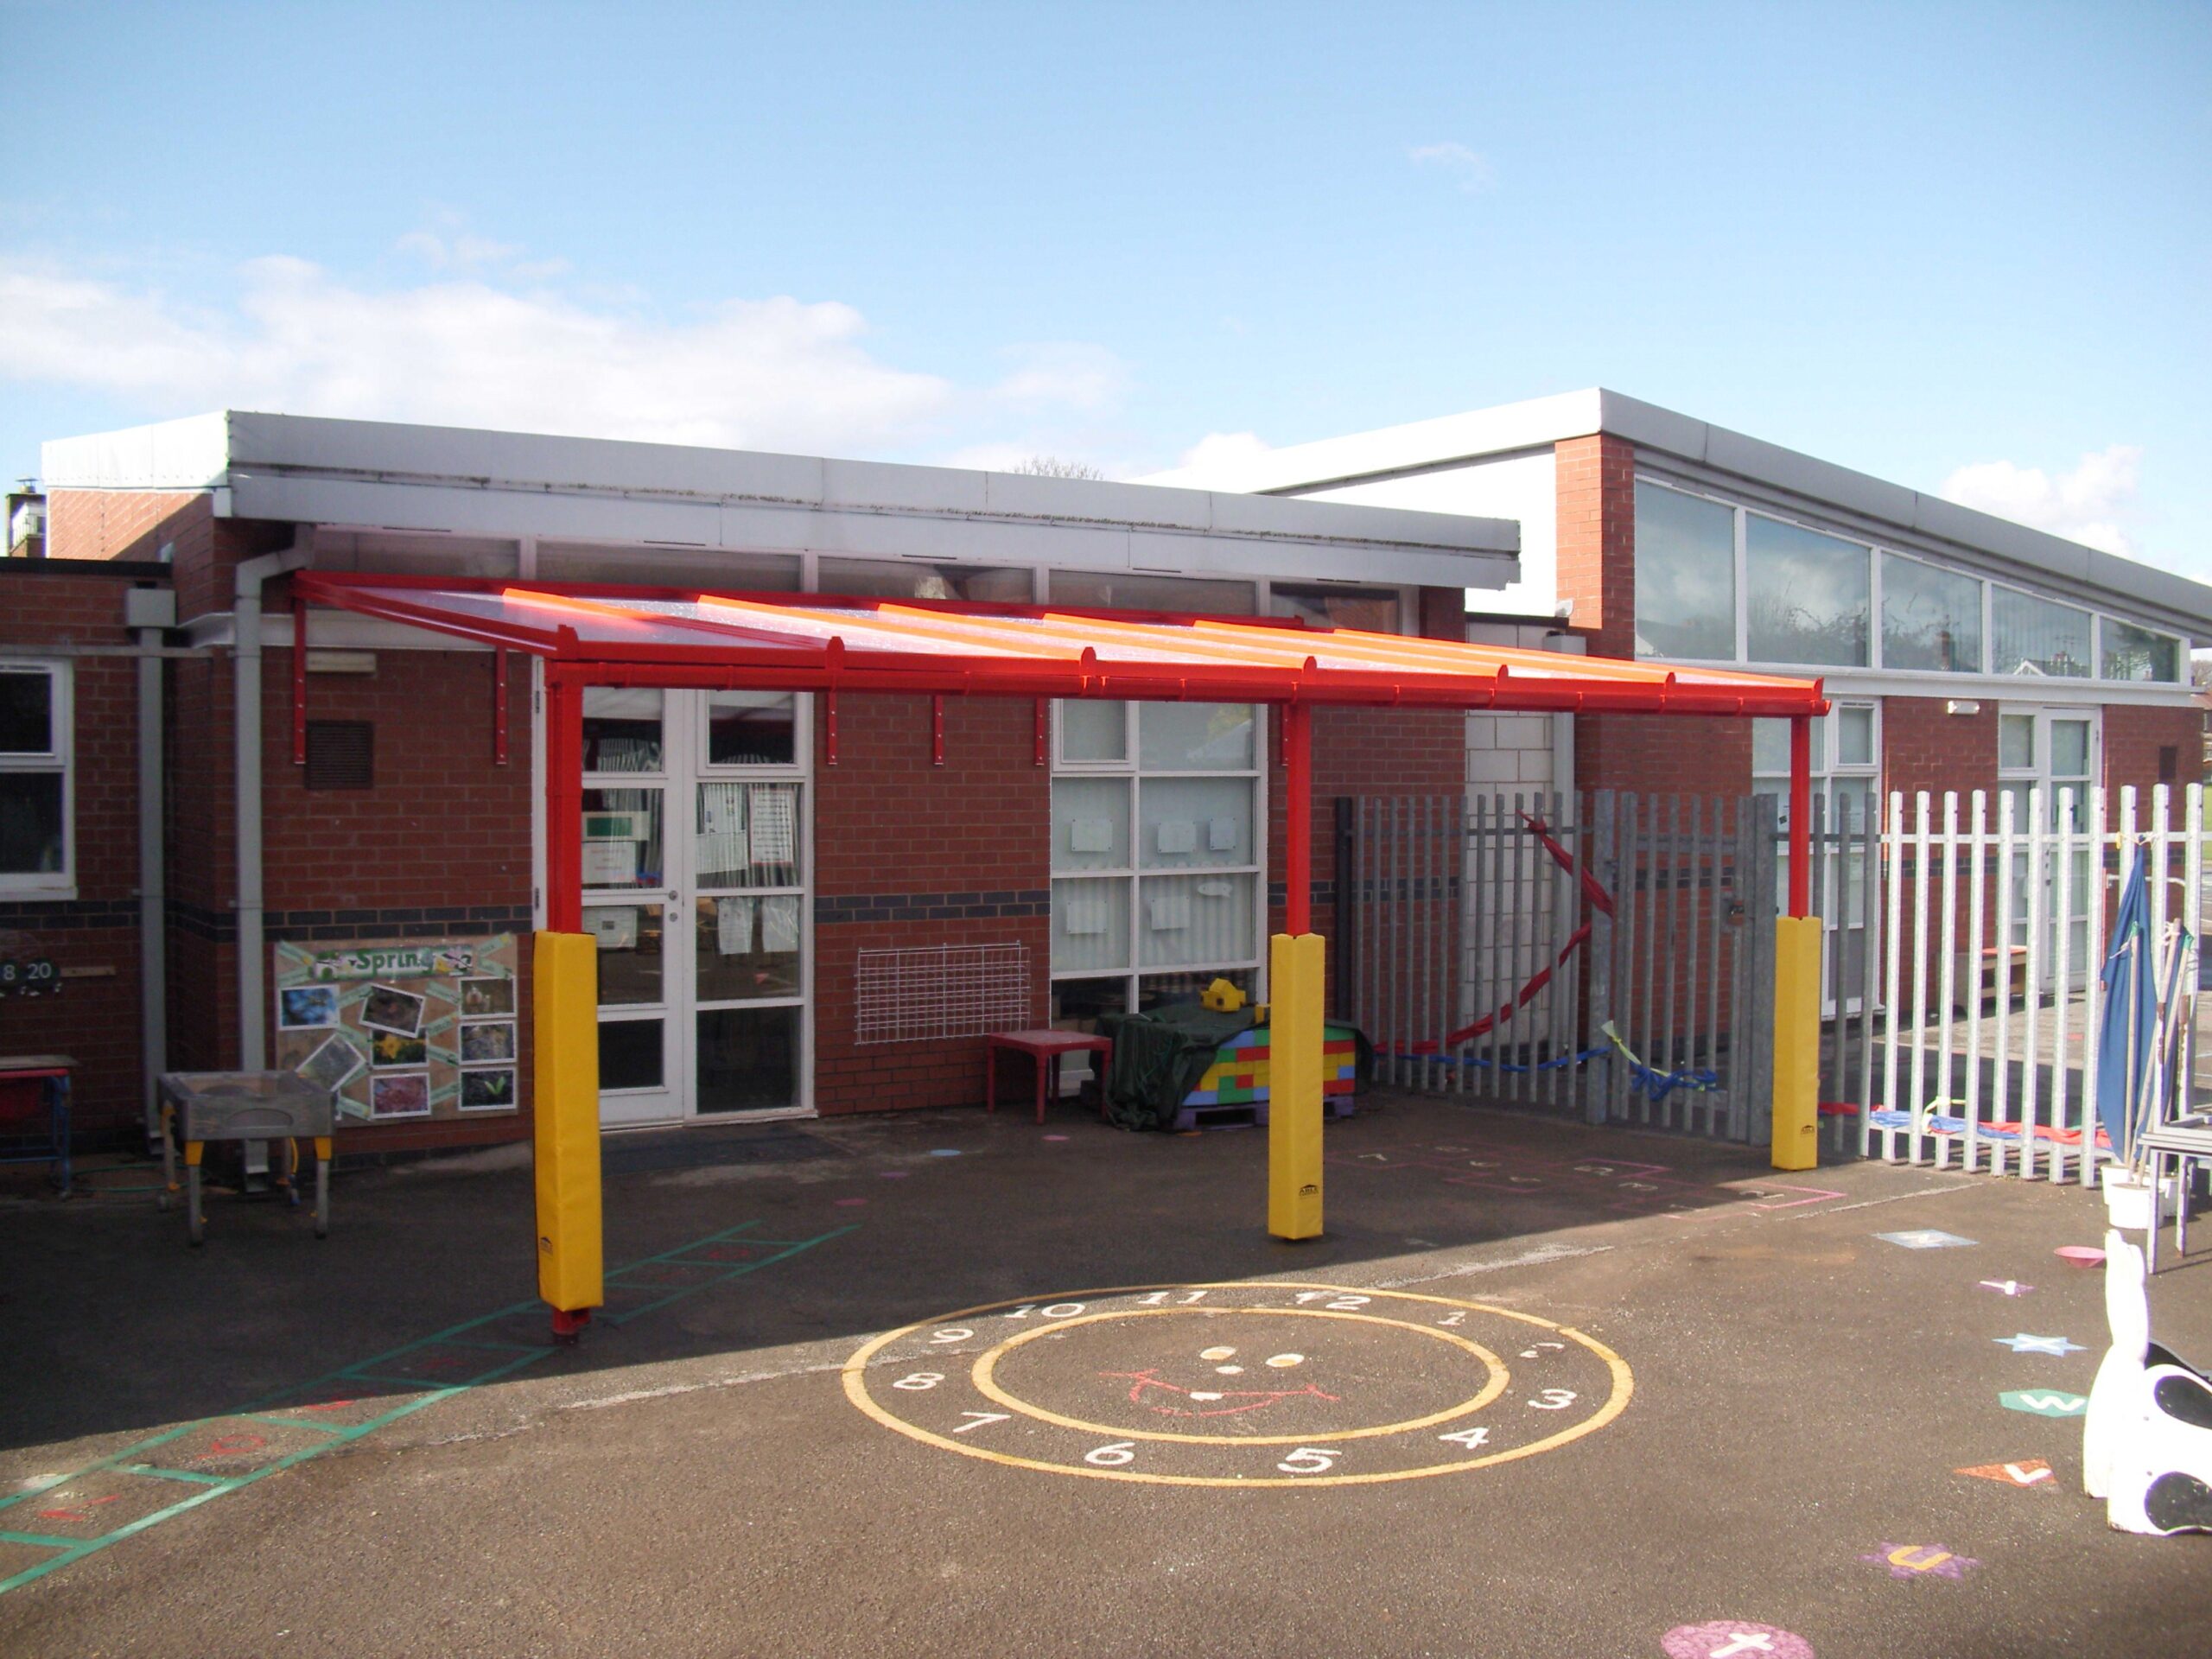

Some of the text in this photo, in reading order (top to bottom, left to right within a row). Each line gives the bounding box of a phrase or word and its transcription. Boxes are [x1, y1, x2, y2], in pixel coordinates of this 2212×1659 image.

[27, 962, 53, 980] 20
[1137, 1290, 1208, 1306] 11
[1004, 1302, 1087, 1319] 10
[929, 1327, 975, 1344] 9
[893, 1371, 945, 1391] 8
[1528, 1388, 1578, 1410] 3
[952, 1411, 1011, 1433] 7
[1438, 1427, 1490, 1449] 4
[1084, 1441, 1136, 1466] 6
[1277, 1446, 1342, 1474] 5
